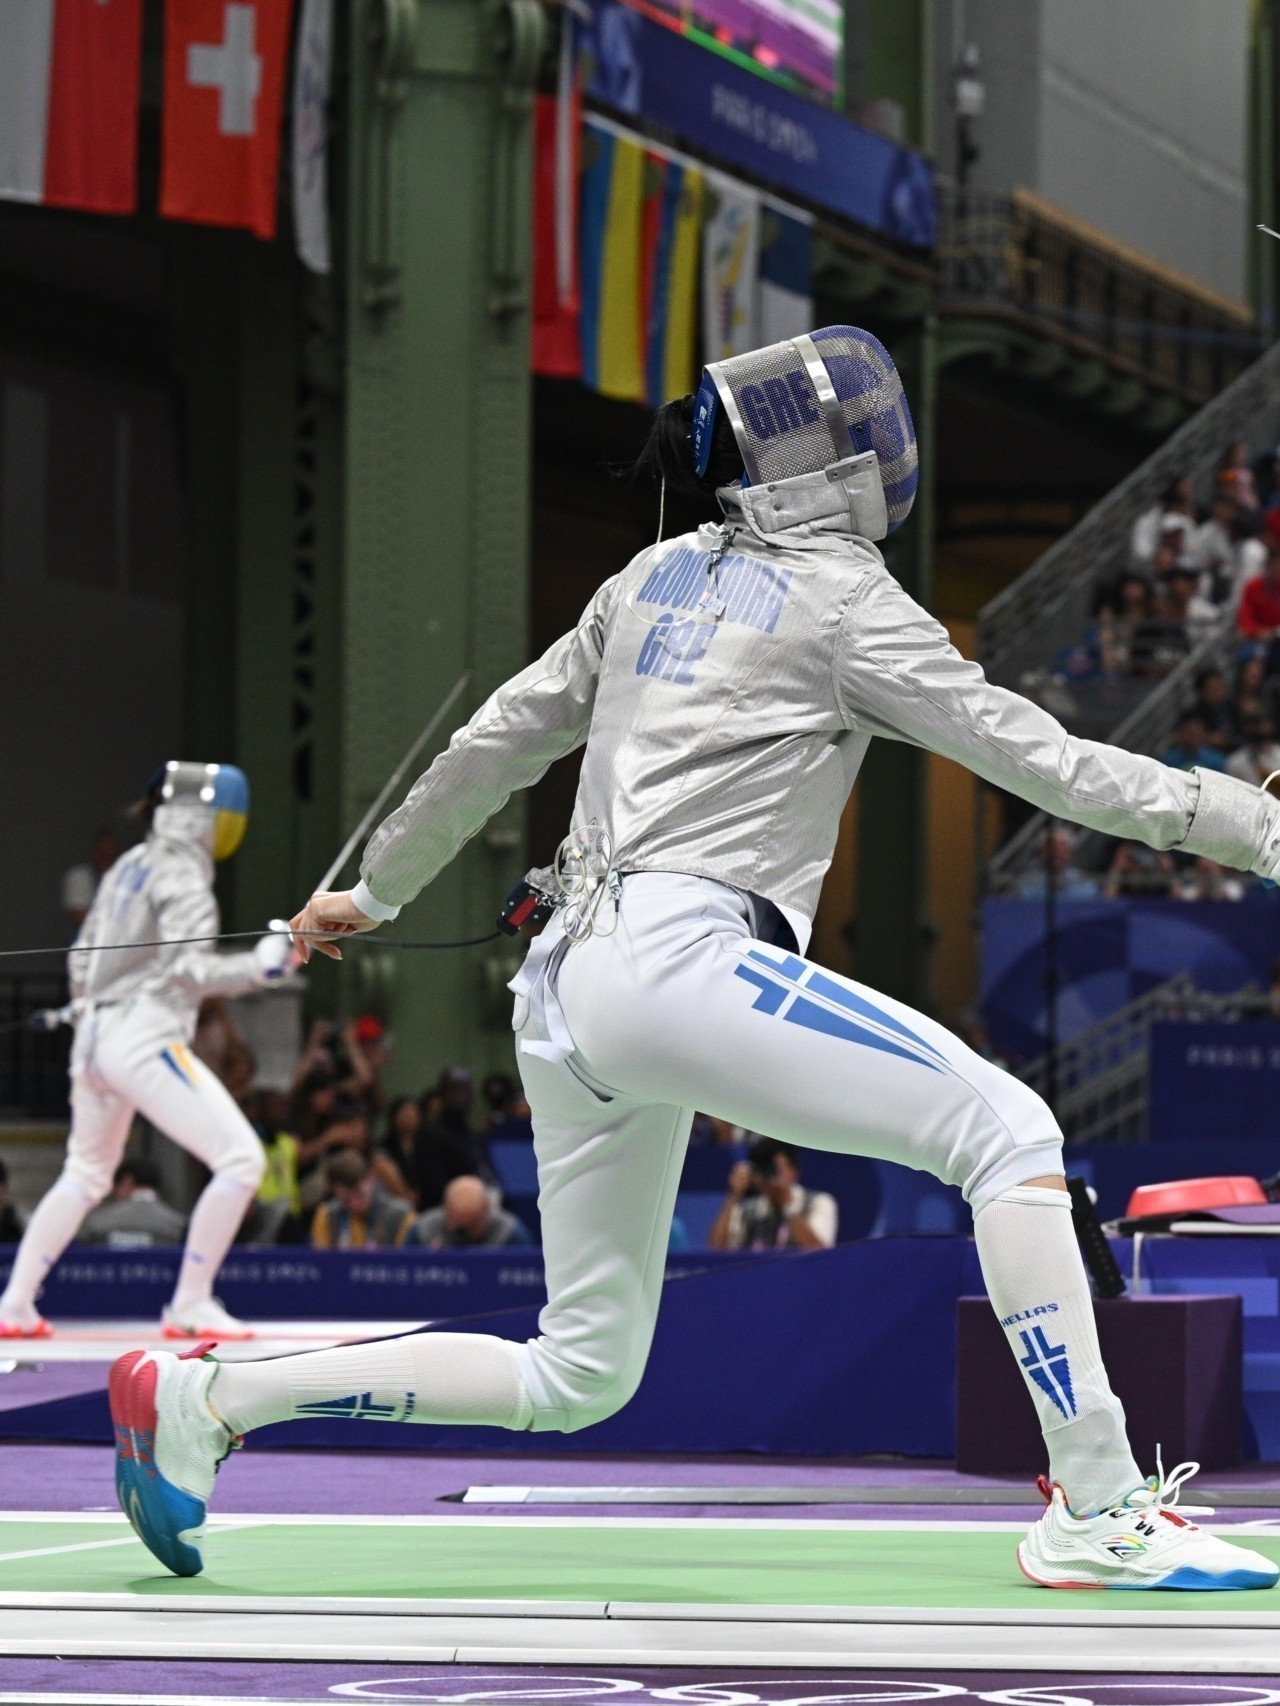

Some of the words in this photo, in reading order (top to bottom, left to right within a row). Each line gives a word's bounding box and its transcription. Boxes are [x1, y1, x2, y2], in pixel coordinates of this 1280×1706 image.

[739, 369, 820, 440] GRE
[635, 613, 719, 687] GRE
[1001, 1303, 1059, 1328] HELLAS
